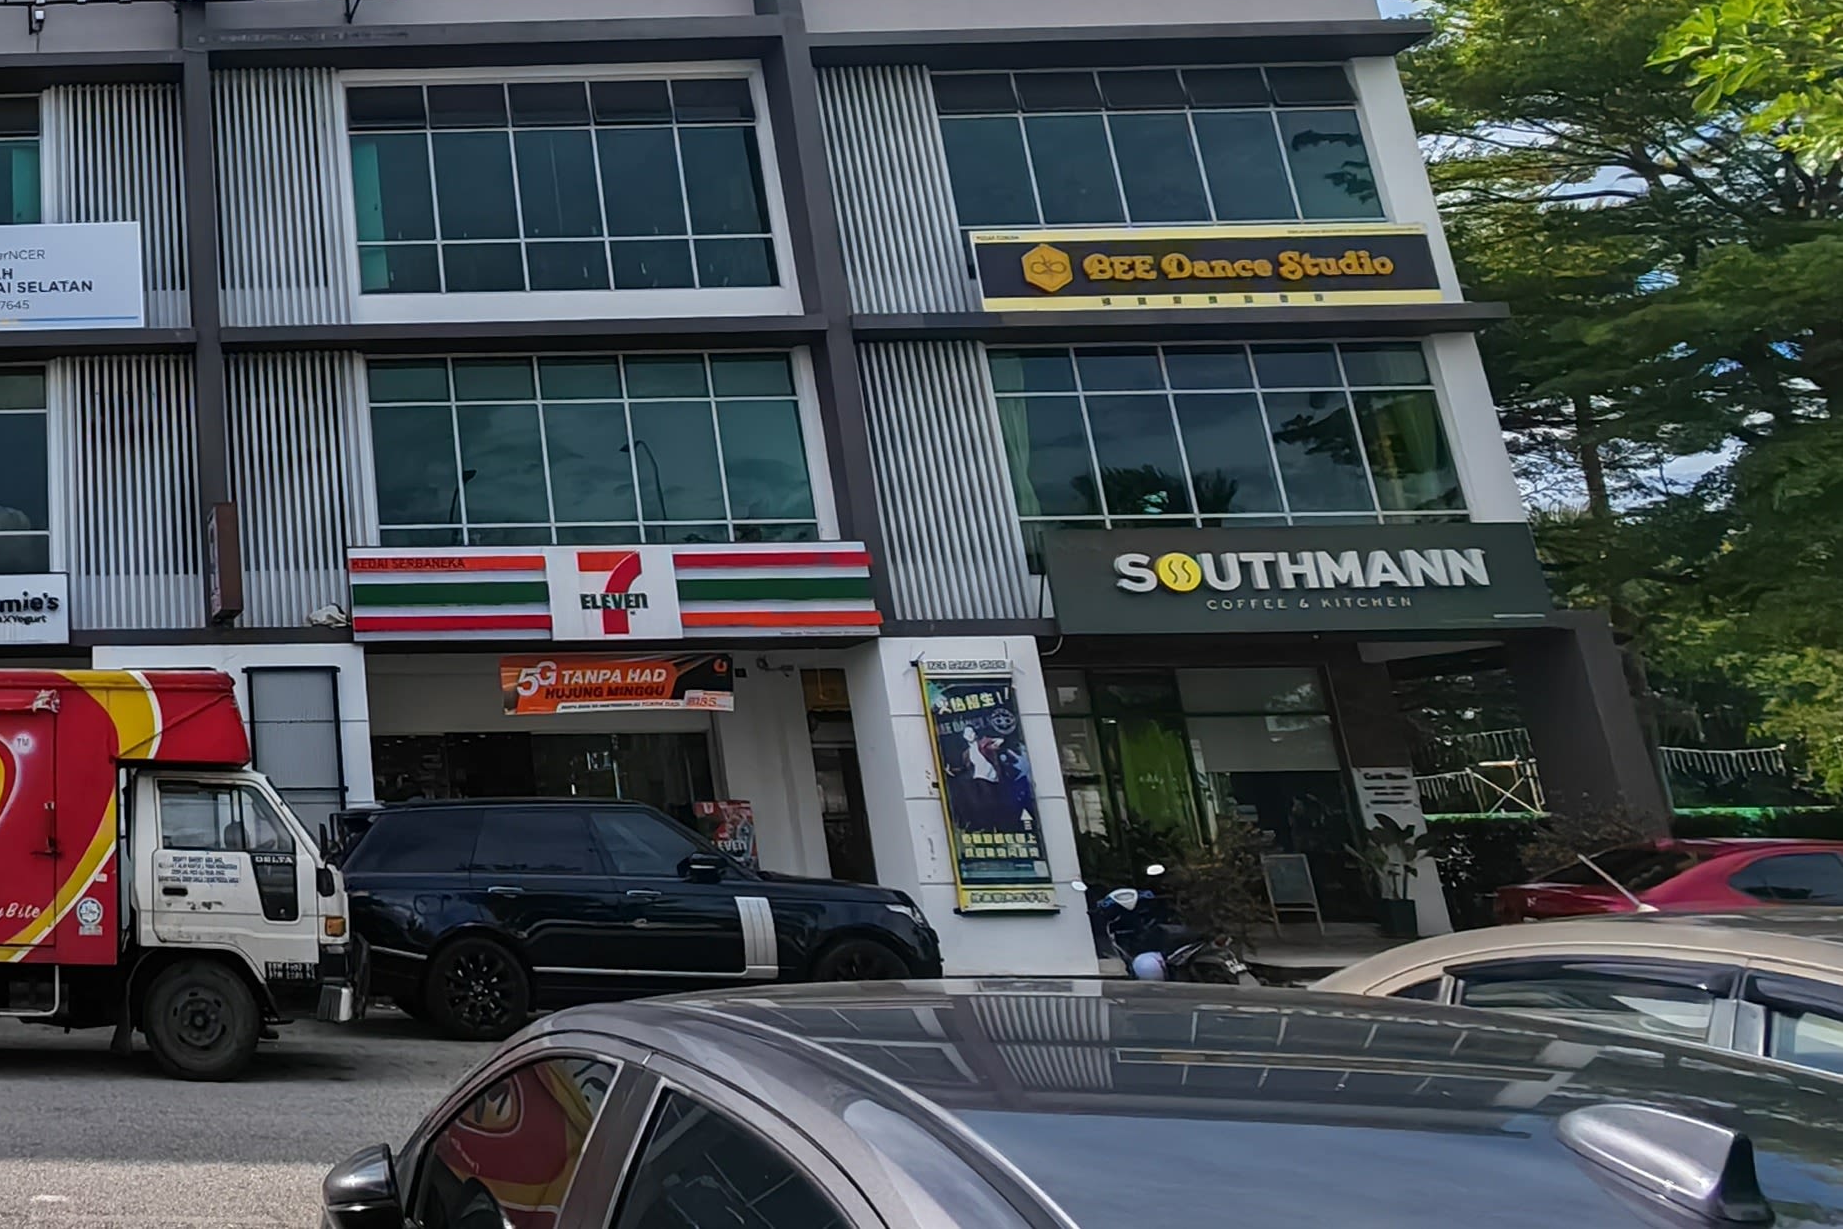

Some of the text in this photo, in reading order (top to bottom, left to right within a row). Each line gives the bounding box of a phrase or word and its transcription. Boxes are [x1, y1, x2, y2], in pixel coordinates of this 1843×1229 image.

[1082, 250, 1394, 281] BEE Dance Studio
[16, 280, 93, 293] SELATAN
[0, 300, 30, 310] 7645
[392, 557, 466, 569] SERBANEKA
[1114, 549, 1492, 592] SOUTHMANN
[577, 551, 642, 635] 7
[1206, 596, 1413, 610] COFFEE & KITCHEN
[516, 660, 667, 697] 5G TANPA HAD
[545, 685, 666, 699] HUJUNG MINGGU
[16, 737, 31, 747] TM
[255, 856, 293, 864] DELTA
[6, 902, 41, 918] Bite
